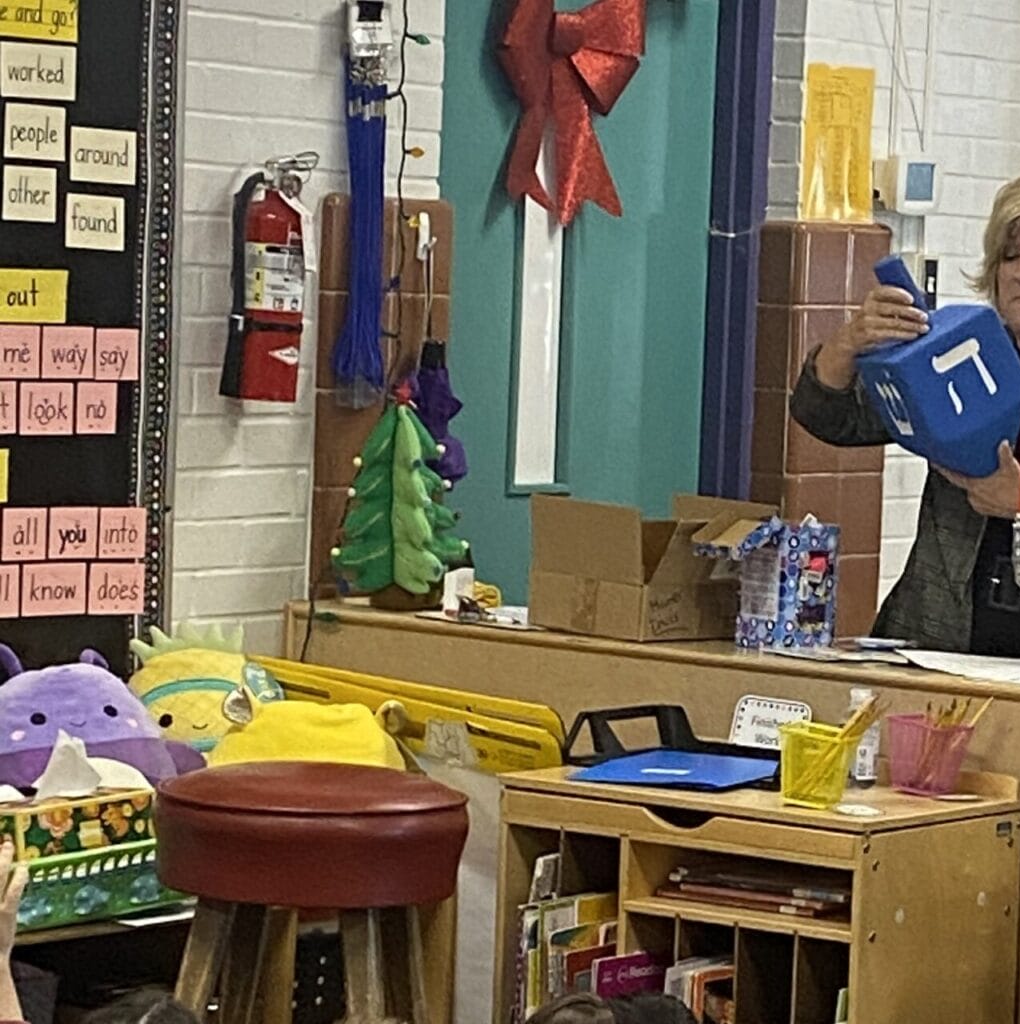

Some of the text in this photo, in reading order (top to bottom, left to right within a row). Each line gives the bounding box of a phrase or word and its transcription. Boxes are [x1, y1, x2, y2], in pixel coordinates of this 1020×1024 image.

[16, 0, 43, 23] and
[8, 54, 64, 84] worked
[10, 117, 57, 151] people
[75, 140, 128, 167] around
[8, 176, 50, 205] other
[72, 204, 118, 234] found
[7, 278, 39, 307] out
[51, 346, 87, 375] way
[100, 348, 128, 380] say
[28, 391, 68, 421] look
[85, 401, 106, 418] no
[13, 516, 138, 554] all you into
[30, 574, 76, 600] know
[98, 572, 139, 601] does
